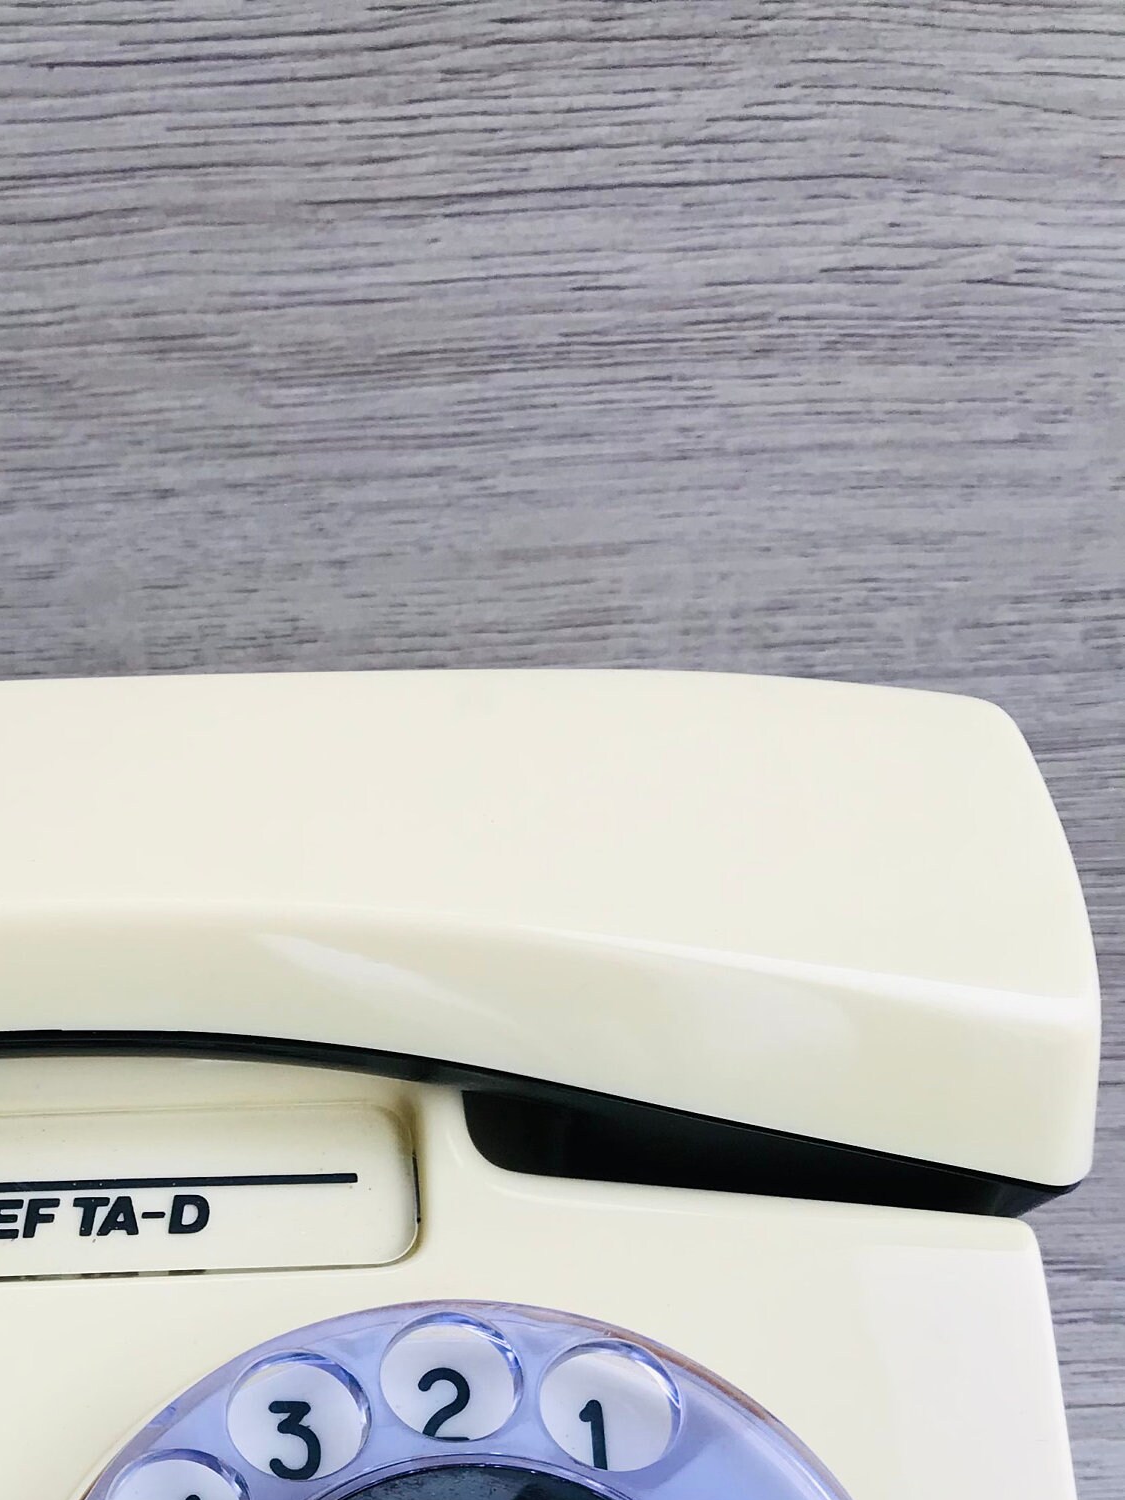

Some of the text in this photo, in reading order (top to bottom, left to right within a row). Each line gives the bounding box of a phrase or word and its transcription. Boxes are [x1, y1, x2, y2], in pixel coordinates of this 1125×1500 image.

[72, 1194, 210, 1237] TA-D
[417, 1366, 472, 1441] 2
[578, 1399, 609, 1471] 1
[267, 1400, 322, 1482] 3
